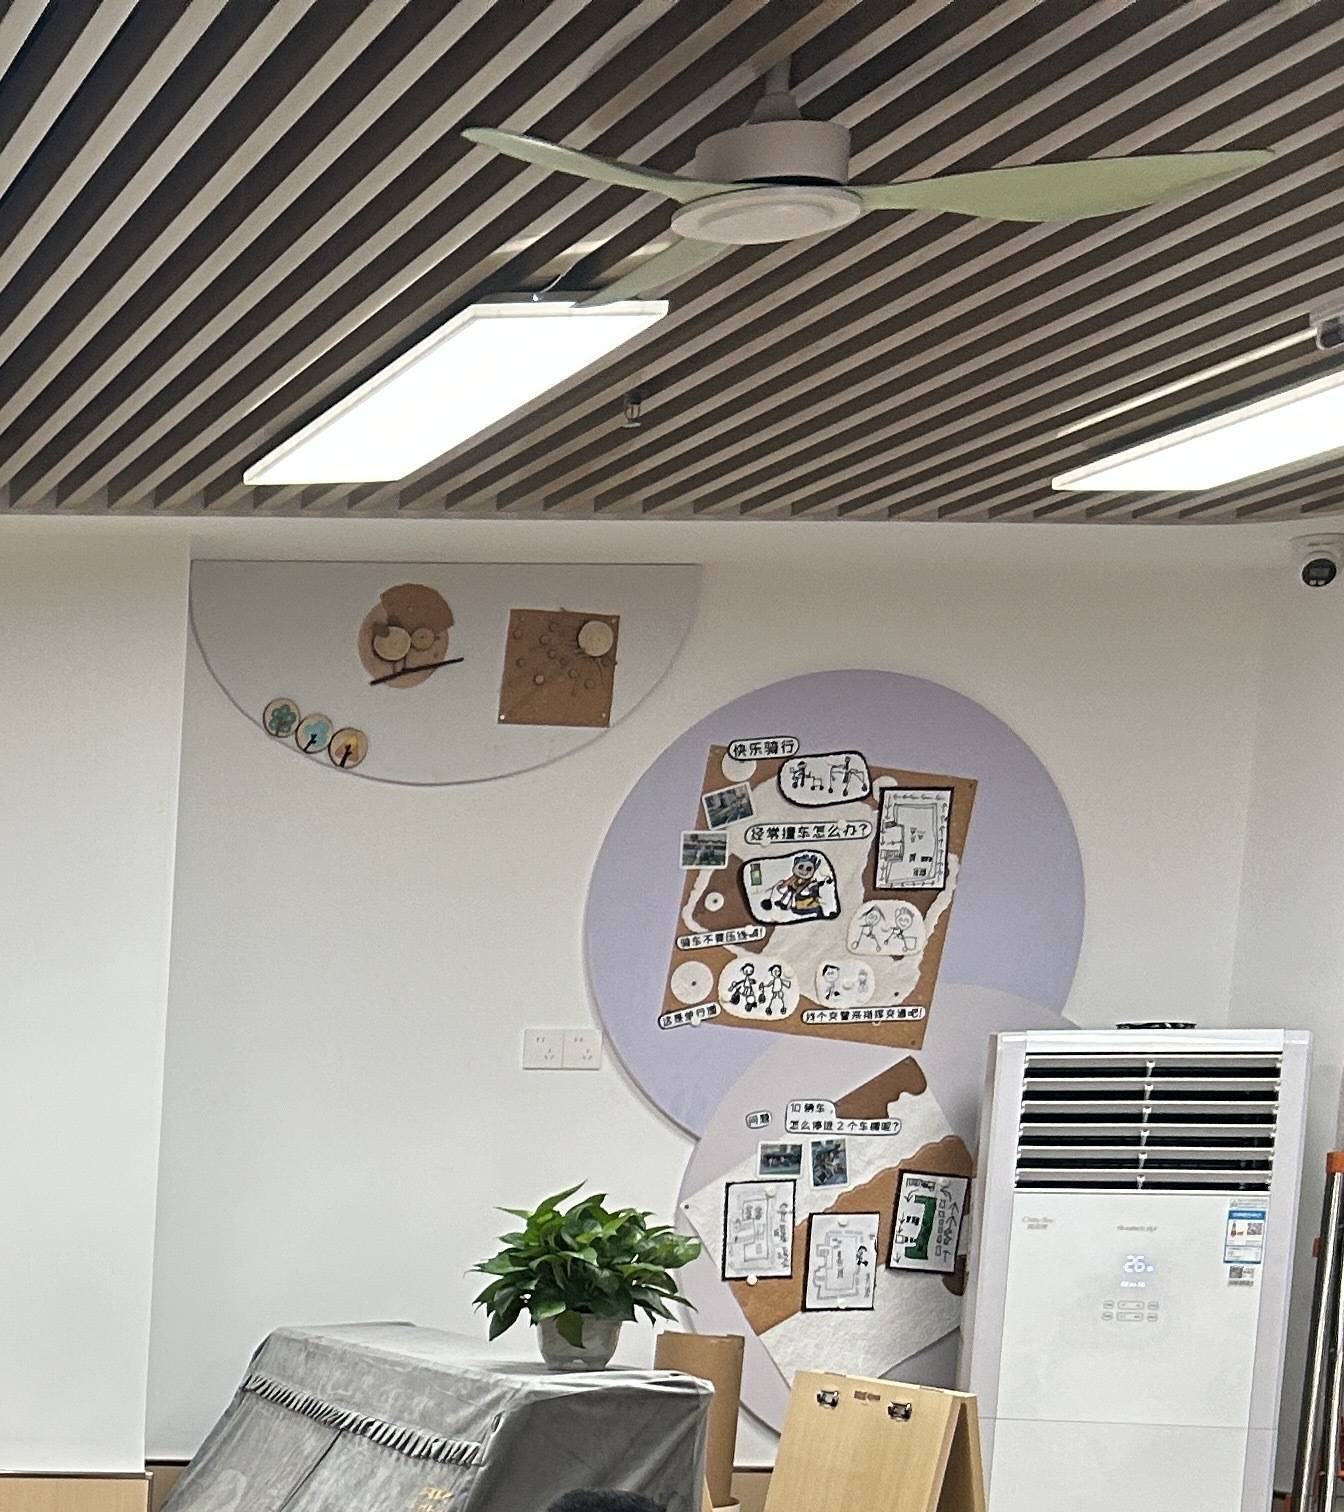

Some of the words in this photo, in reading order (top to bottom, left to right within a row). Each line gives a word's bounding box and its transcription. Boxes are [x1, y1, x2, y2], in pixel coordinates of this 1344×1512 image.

[733, 740, 795, 757] 快乐骑行
[750, 824, 867, 840] 经常撞车怎么办？
